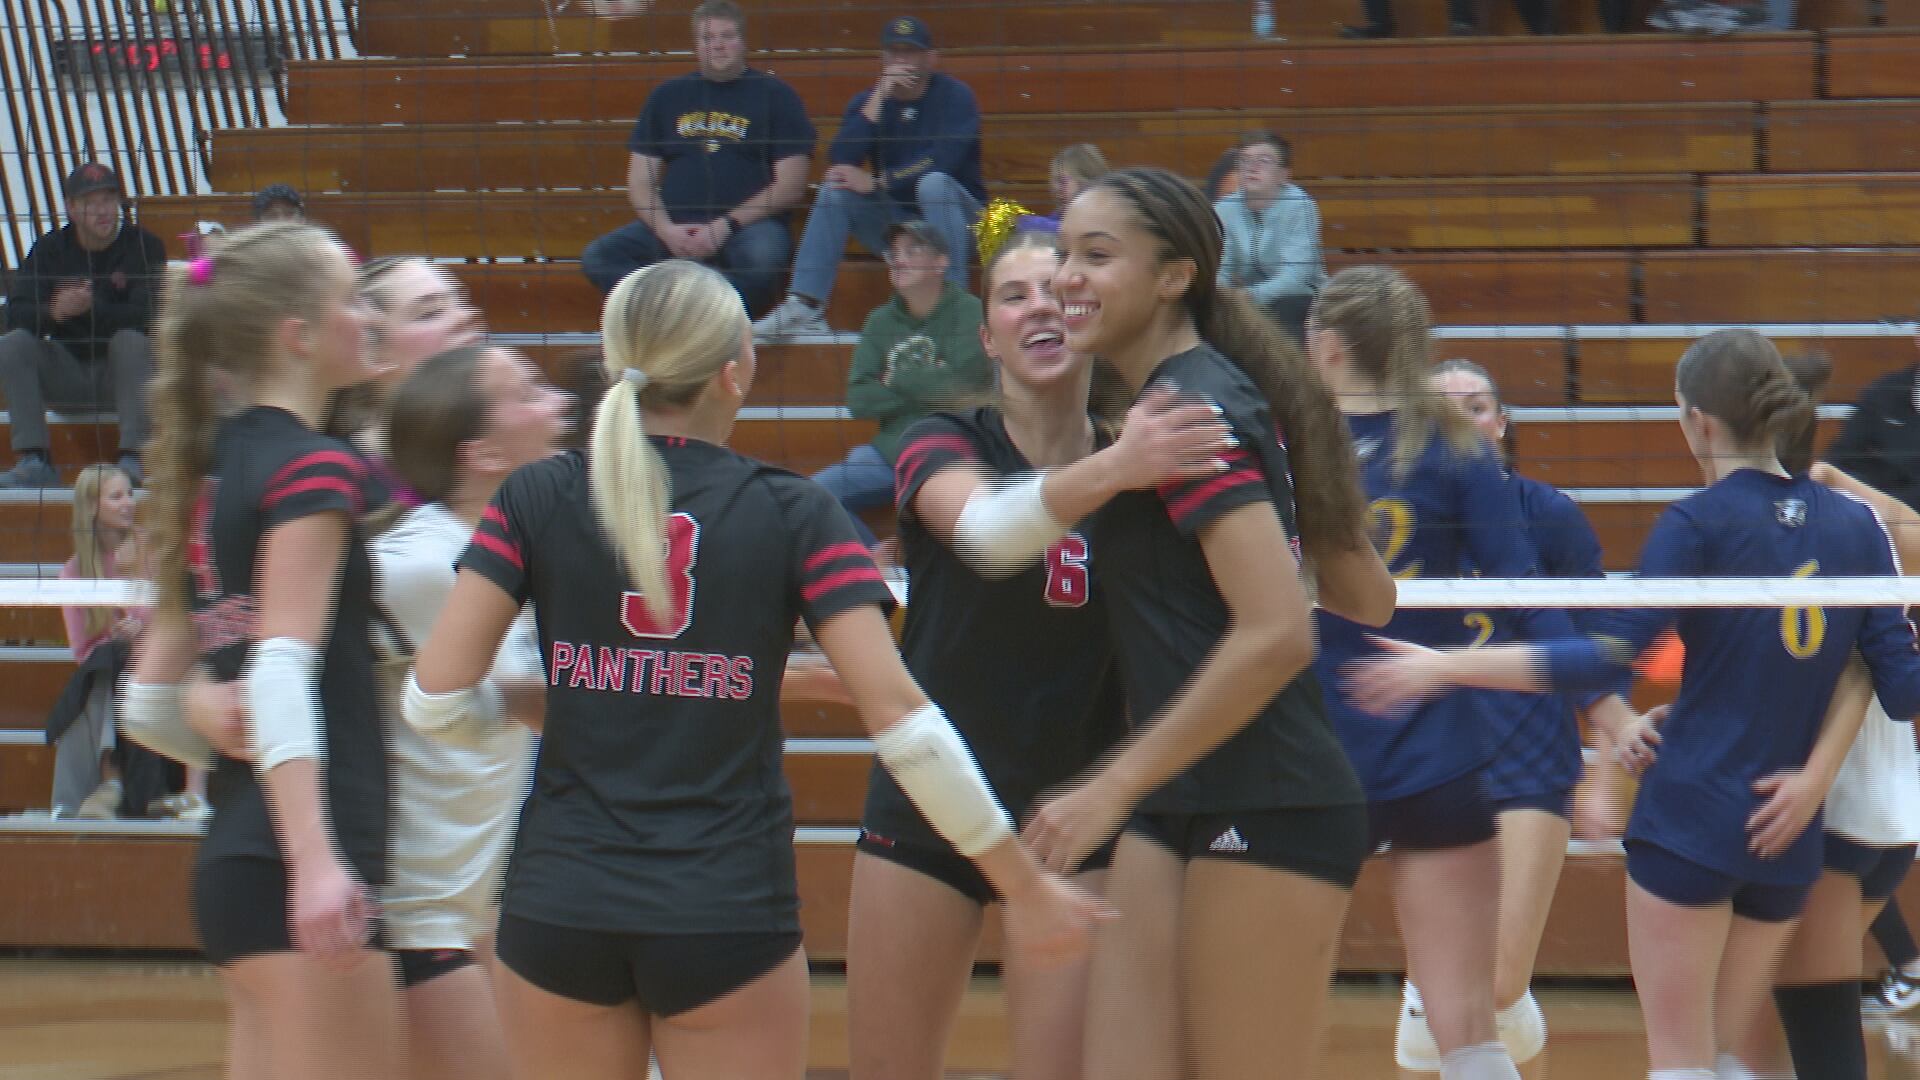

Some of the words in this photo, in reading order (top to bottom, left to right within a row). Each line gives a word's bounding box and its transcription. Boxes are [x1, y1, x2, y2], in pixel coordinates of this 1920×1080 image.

[620, 512, 700, 639] 3
[1044, 533, 1089, 608] 6
[1364, 497, 1424, 580] 2
[1779, 558, 1828, 660] 6
[551, 640, 754, 700] PANTHERS
